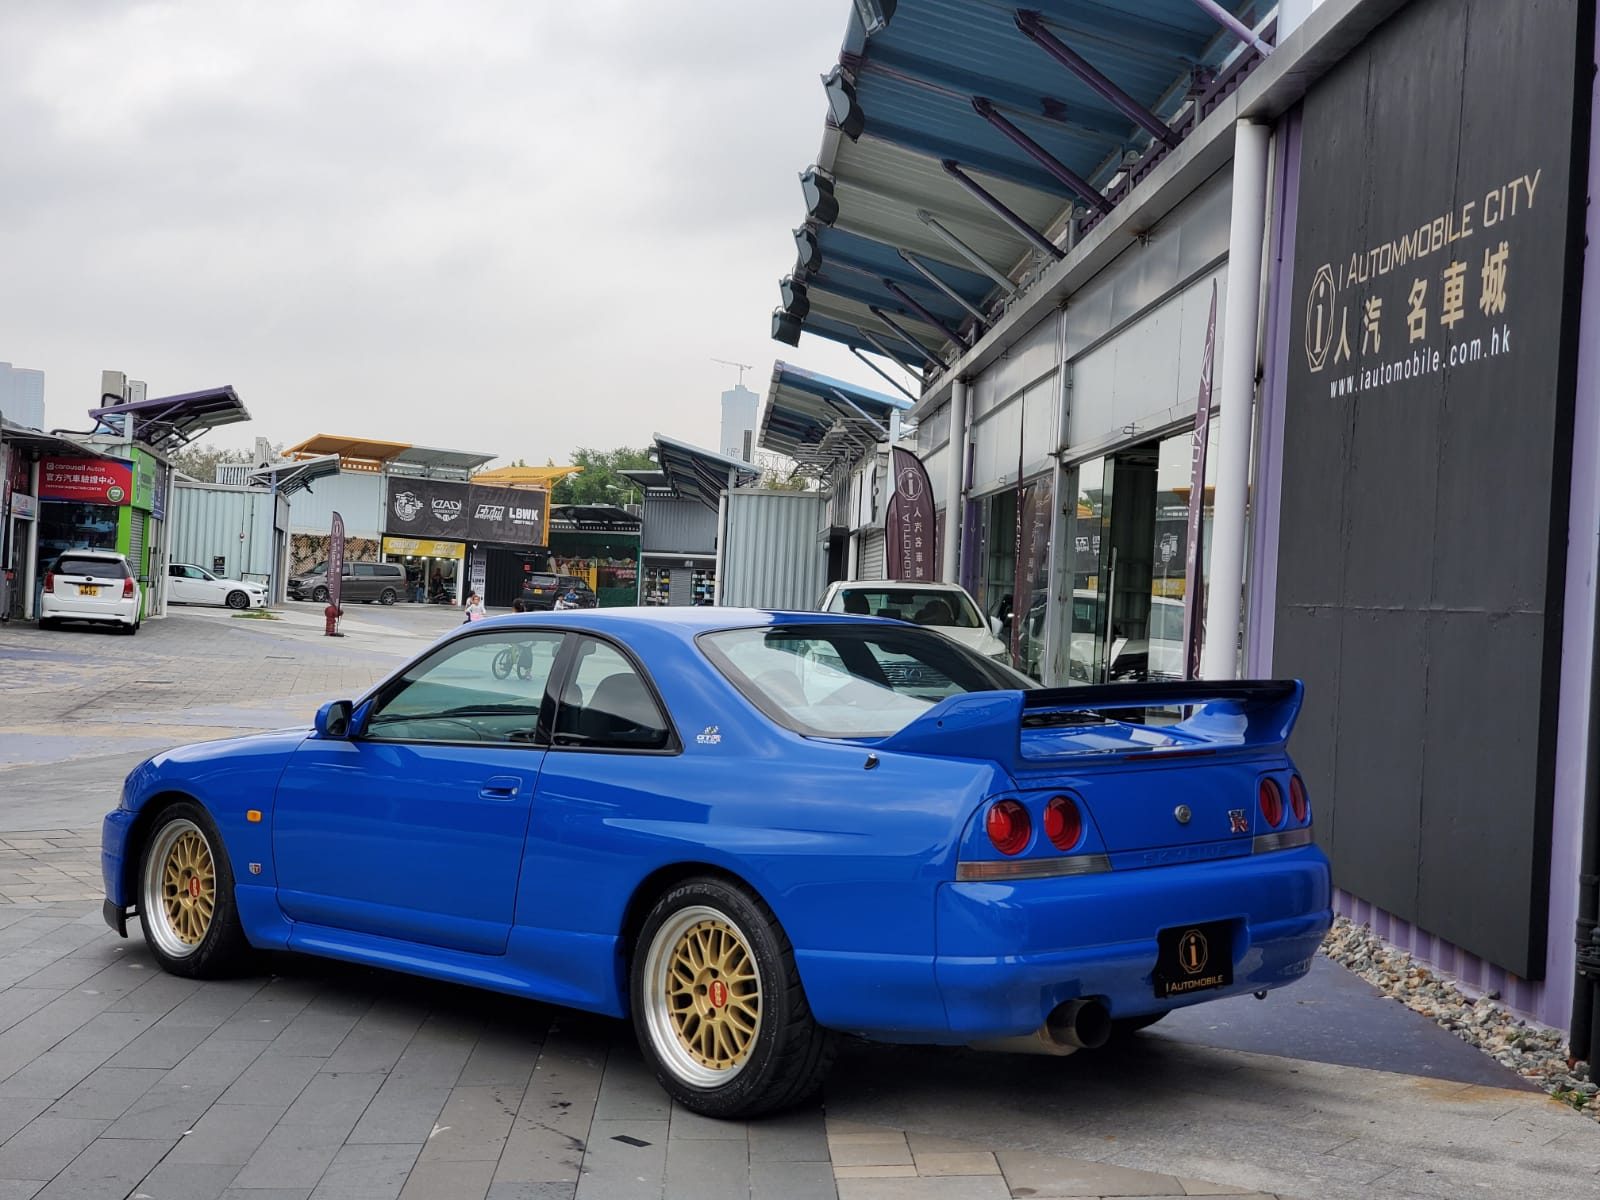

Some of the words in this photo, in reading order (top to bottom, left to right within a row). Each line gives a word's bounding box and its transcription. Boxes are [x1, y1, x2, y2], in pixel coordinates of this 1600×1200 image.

[1345, 201, 1476, 289] AUTOMMOBILE
[1483, 168, 1542, 228] CITY
[1330, 323, 1512, 399] www.iautomobile.com.hk
[508, 507, 539, 521] LBWK
[1170, 974, 1224, 992] AUTOMOBILE
